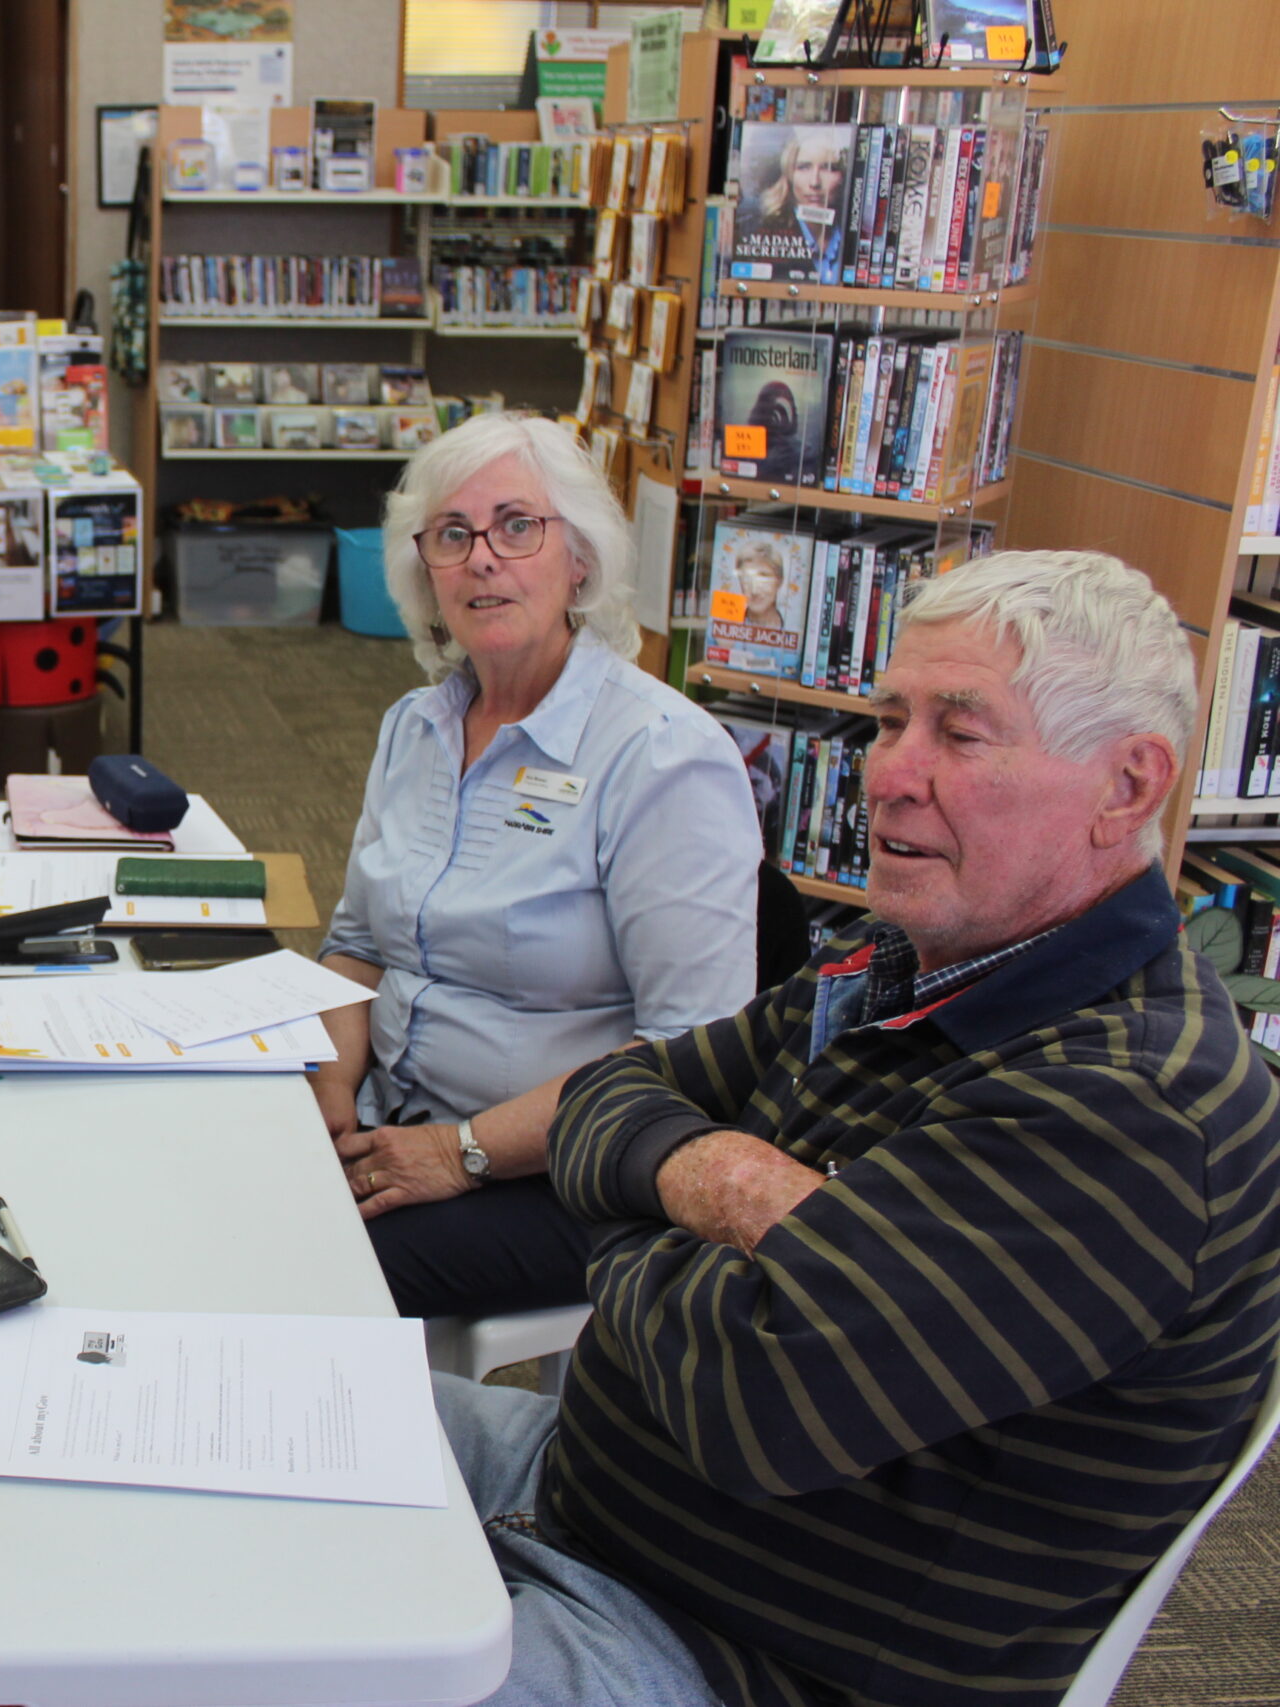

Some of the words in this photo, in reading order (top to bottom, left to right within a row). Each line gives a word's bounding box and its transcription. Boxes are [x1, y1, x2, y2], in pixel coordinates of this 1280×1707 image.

[905, 139, 931, 217] ROME
[958, 157, 969, 178] REX
[849, 177, 863, 232] RADIOACTIVE
[952, 180, 967, 220] SPECIAL
[749, 233, 804, 247] MADAM
[950, 221, 961, 248] UNIT
[736, 244, 815, 259] SECRETARY
[729, 345, 818, 371] monsterland
[713, 622, 753, 641] NURSE
[1224, 632, 1234, 654] THE
[1218, 657, 1230, 700] HIDDEN
[33, 1394, 51, 1422] myGov
[30, 1423, 47, 1445] about
